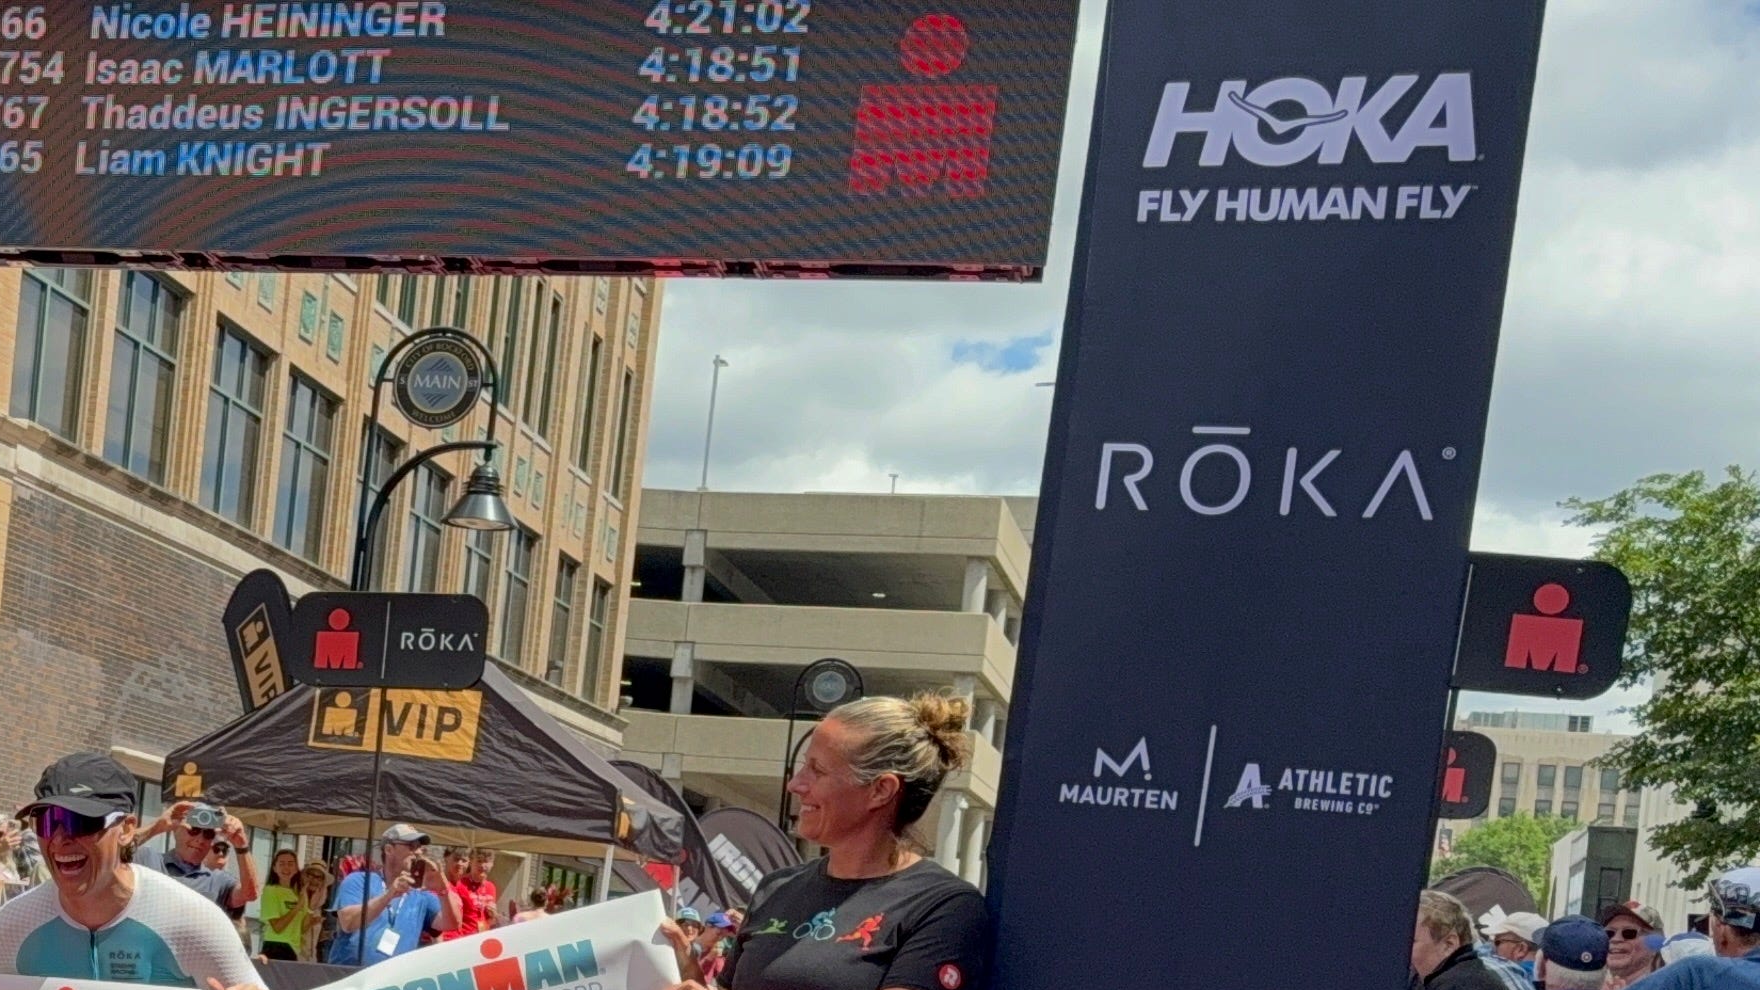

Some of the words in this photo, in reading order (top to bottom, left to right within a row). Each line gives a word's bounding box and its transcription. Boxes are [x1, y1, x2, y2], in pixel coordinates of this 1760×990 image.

[1, 7, 47, 39] 66
[90, 2, 211, 39] Nicole
[221, 1, 447, 38] HEININGER
[645, 0, 811, 34] 4:21:02
[85, 51, 184, 84] Isaac
[193, 49, 391, 84] MARLOTT
[638, 46, 800, 82] 4:18:51
[82, 94, 264, 130] Thaddeus
[275, 95, 510, 130] INGERSOLL
[632, 94, 798, 130] 4:18:52
[1142, 73, 1476, 167] HOKA
[75, 140, 167, 175] Liam
[176, 142, 331, 176] KNIGHT
[626, 144, 792, 179] 4:19:09
[1137, 189, 1208, 223] FLY
[1214, 186, 1387, 222] HUMAN
[1395, 184, 1471, 221] FLY
[414, 374, 462, 389] MAIN
[384, 699, 463, 742] VIP
[1059, 783, 1178, 811] MAURTEN
[1277, 768, 1393, 798] ATHLETIC
[1294, 798, 1354, 814] BREWING
